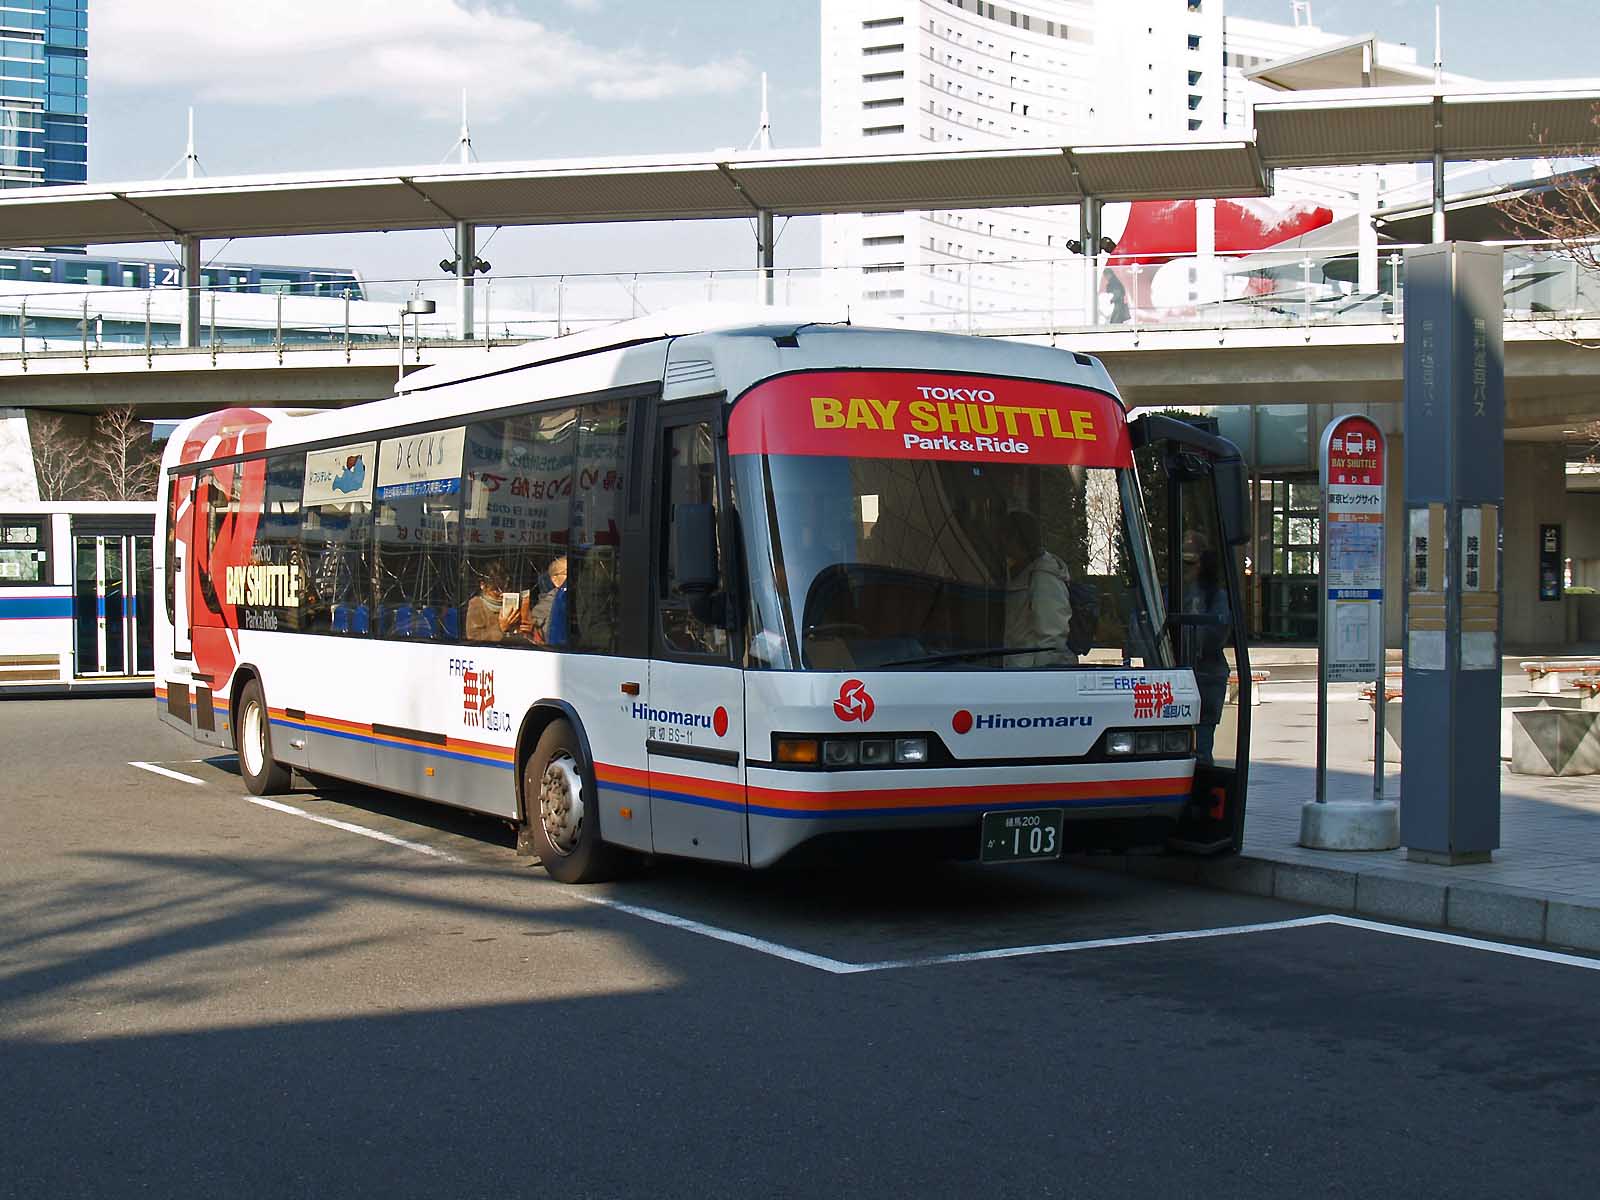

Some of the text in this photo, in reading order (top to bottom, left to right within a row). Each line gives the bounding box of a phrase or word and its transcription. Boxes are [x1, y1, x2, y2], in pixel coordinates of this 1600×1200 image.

[161, 268, 179, 285] 21
[917, 386, 995, 402] TOKYO
[810, 397, 1097, 441] BAY SHUTTLE
[396, 435, 446, 471] DECKS
[1331, 458, 1377, 469] BAY SHUTTLE
[1328, 493, 1379, 505] 東京ビッグサイト
[226, 565, 299, 607] BAY SHUTTLE
[449, 658, 474, 677] FREE
[463, 667, 495, 729] 無料
[1133, 681, 1174, 719] 無料
[632, 702, 711, 729] Hinomaru
[1162, 704, 1192, 719] 巡回バス
[976, 713, 1093, 729] Hinomaru
[668, 727, 693, 745] BS-11
